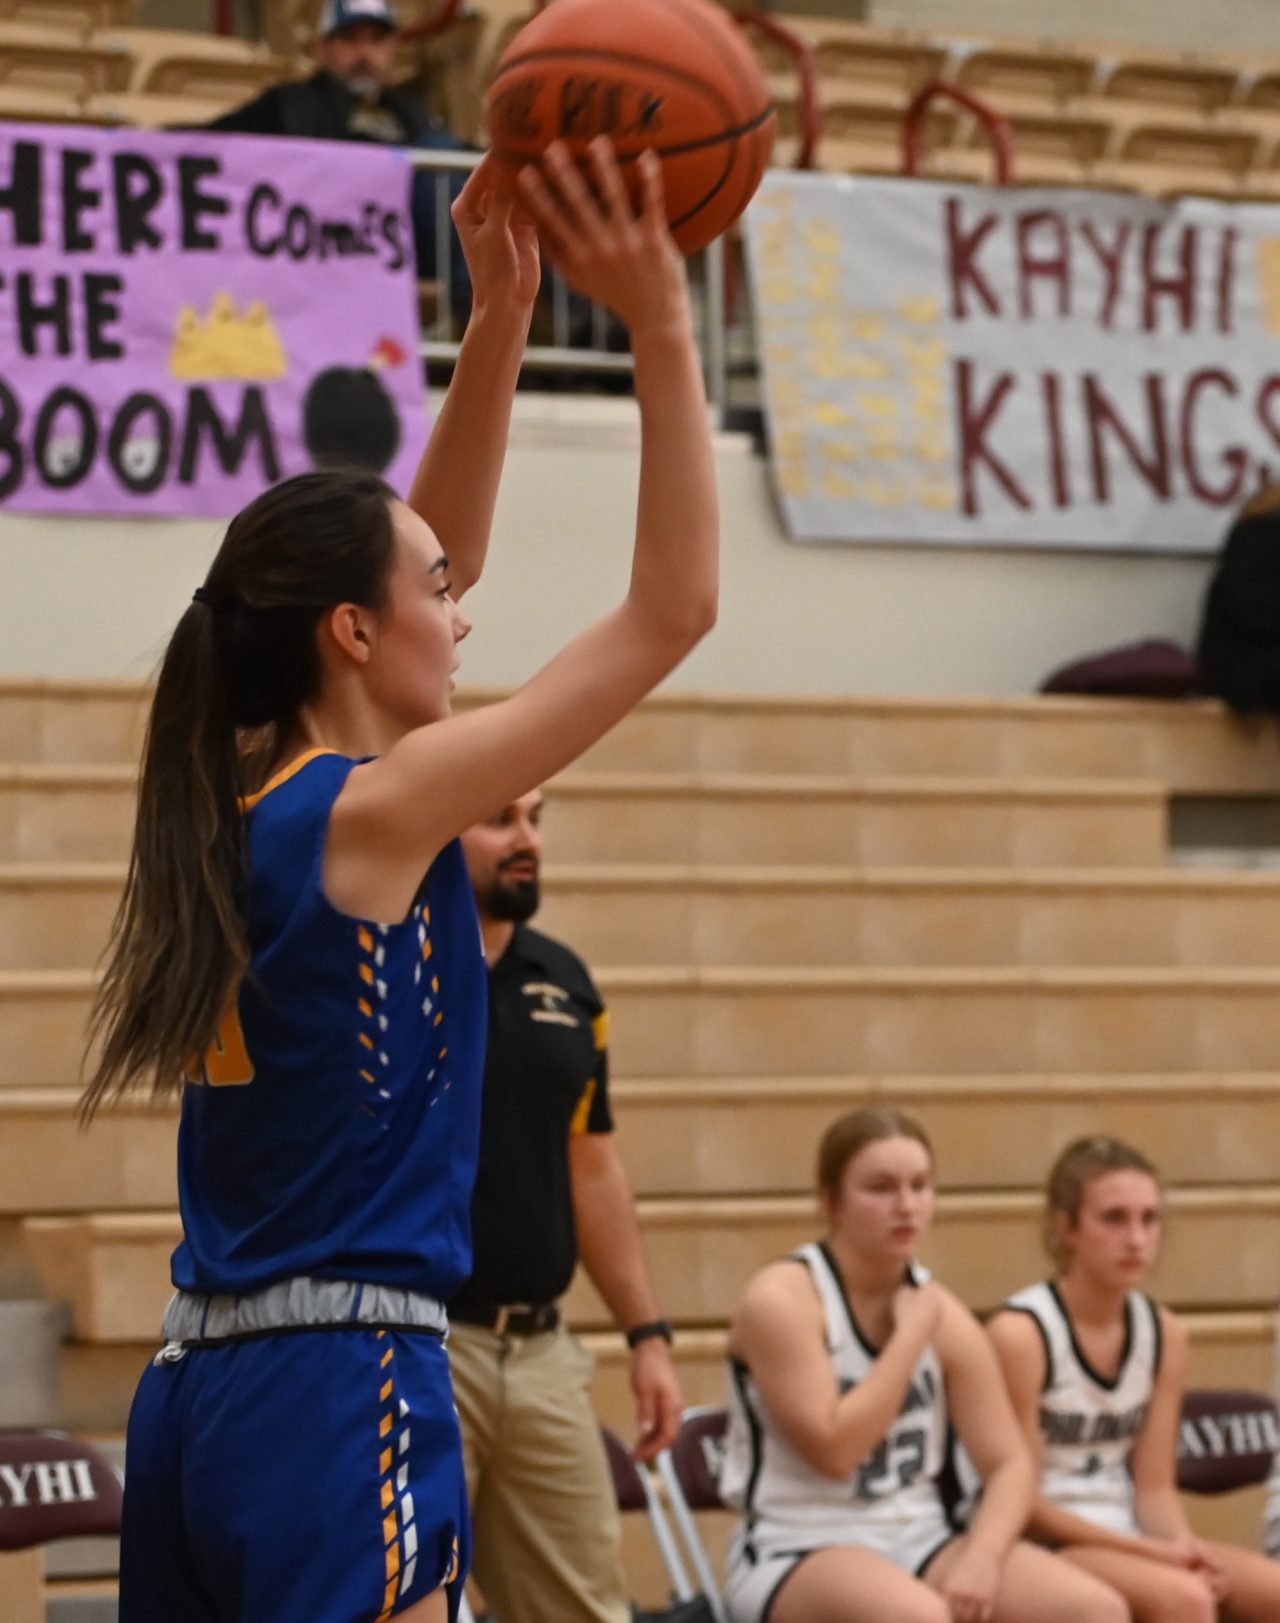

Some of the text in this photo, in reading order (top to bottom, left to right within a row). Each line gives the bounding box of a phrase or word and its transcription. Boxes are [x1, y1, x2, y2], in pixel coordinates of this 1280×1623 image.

[944, 197, 1237, 336] KAYHI
[0, 271, 122, 360] HE
[0, 1459, 95, 1507] YHI
